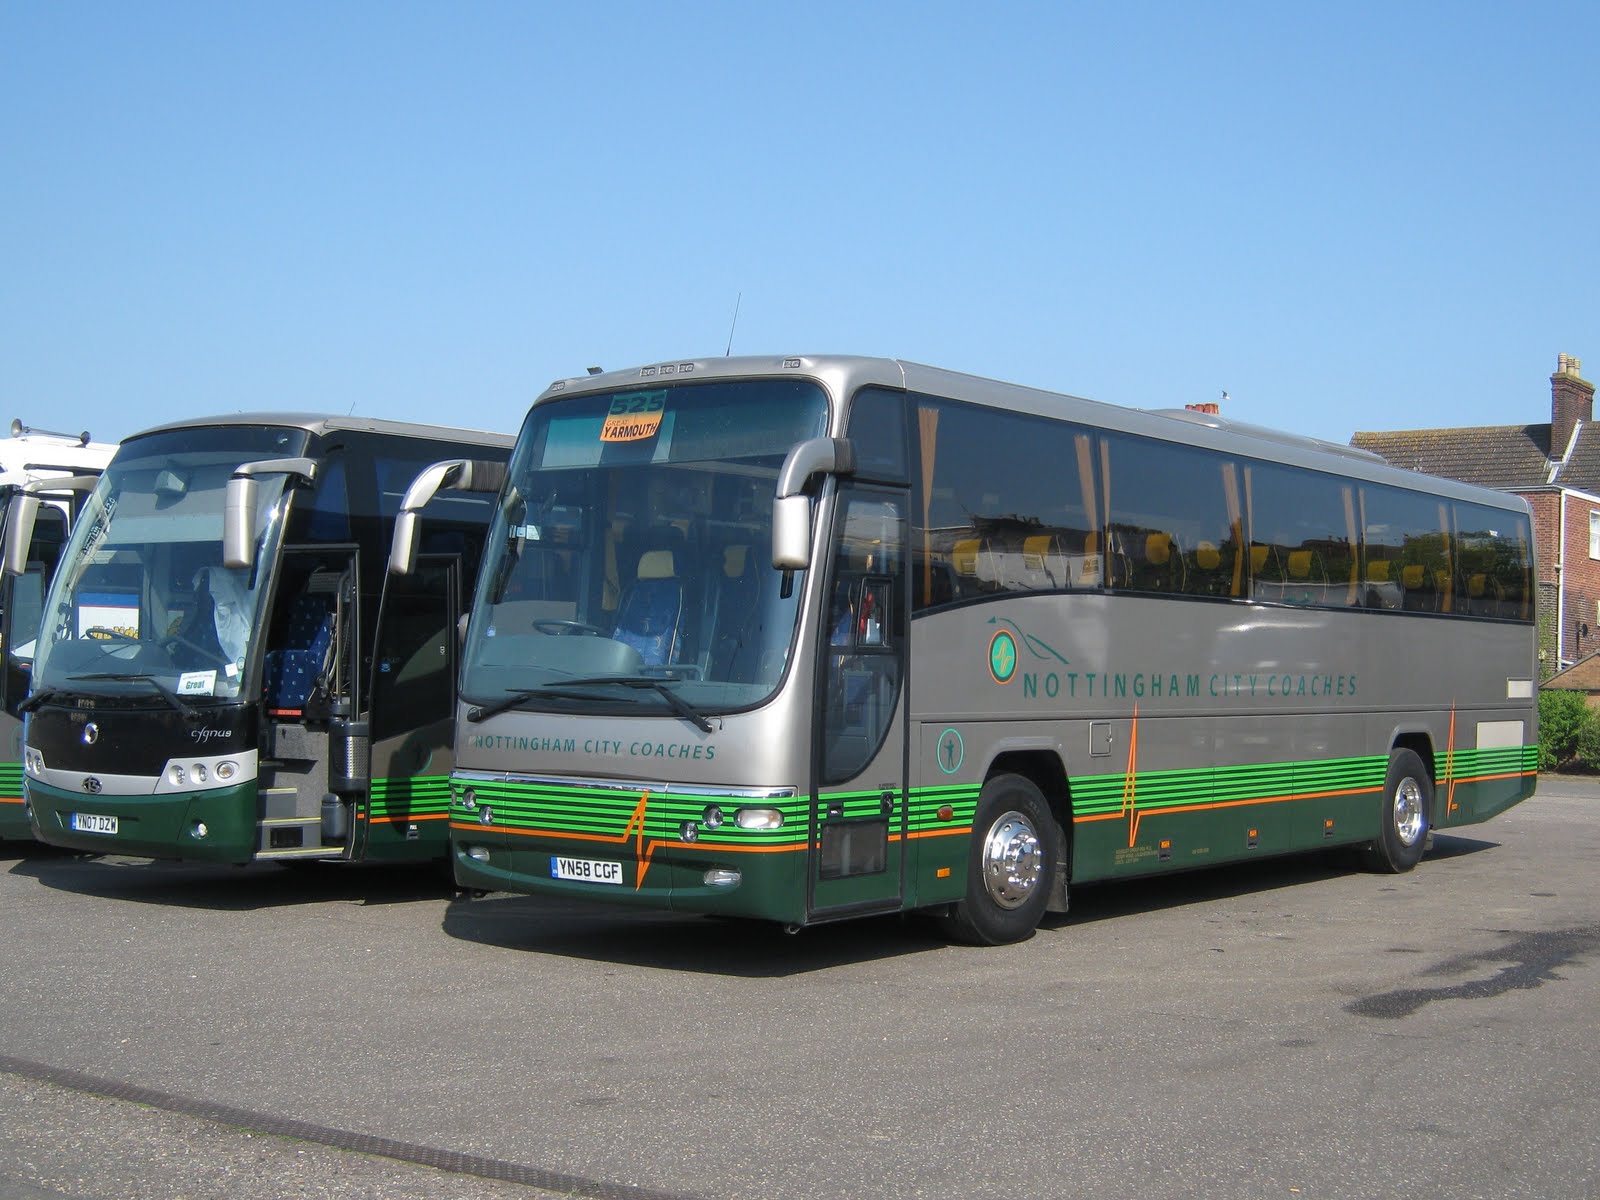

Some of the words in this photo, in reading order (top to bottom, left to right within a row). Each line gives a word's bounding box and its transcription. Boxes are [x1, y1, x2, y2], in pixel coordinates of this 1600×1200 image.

[610, 395, 664, 415] 525
[604, 423, 657, 438] YARMOUTH
[185, 680, 206, 689] Great
[1023, 673, 1200, 698] NOTTINGHAM
[1209, 674, 1257, 697] CITY
[1267, 674, 1357, 697] COACHES
[191, 726, 232, 743] cygnus
[475, 735, 576, 753] NOTTINGHAM
[584, 740, 622, 754] CITY
[630, 742, 716, 760] COACHES
[77, 814, 97, 829] YN07
[99, 817, 116, 831] DZW
[559, 859, 591, 877] YN58
[594, 863, 619, 879] CGF
